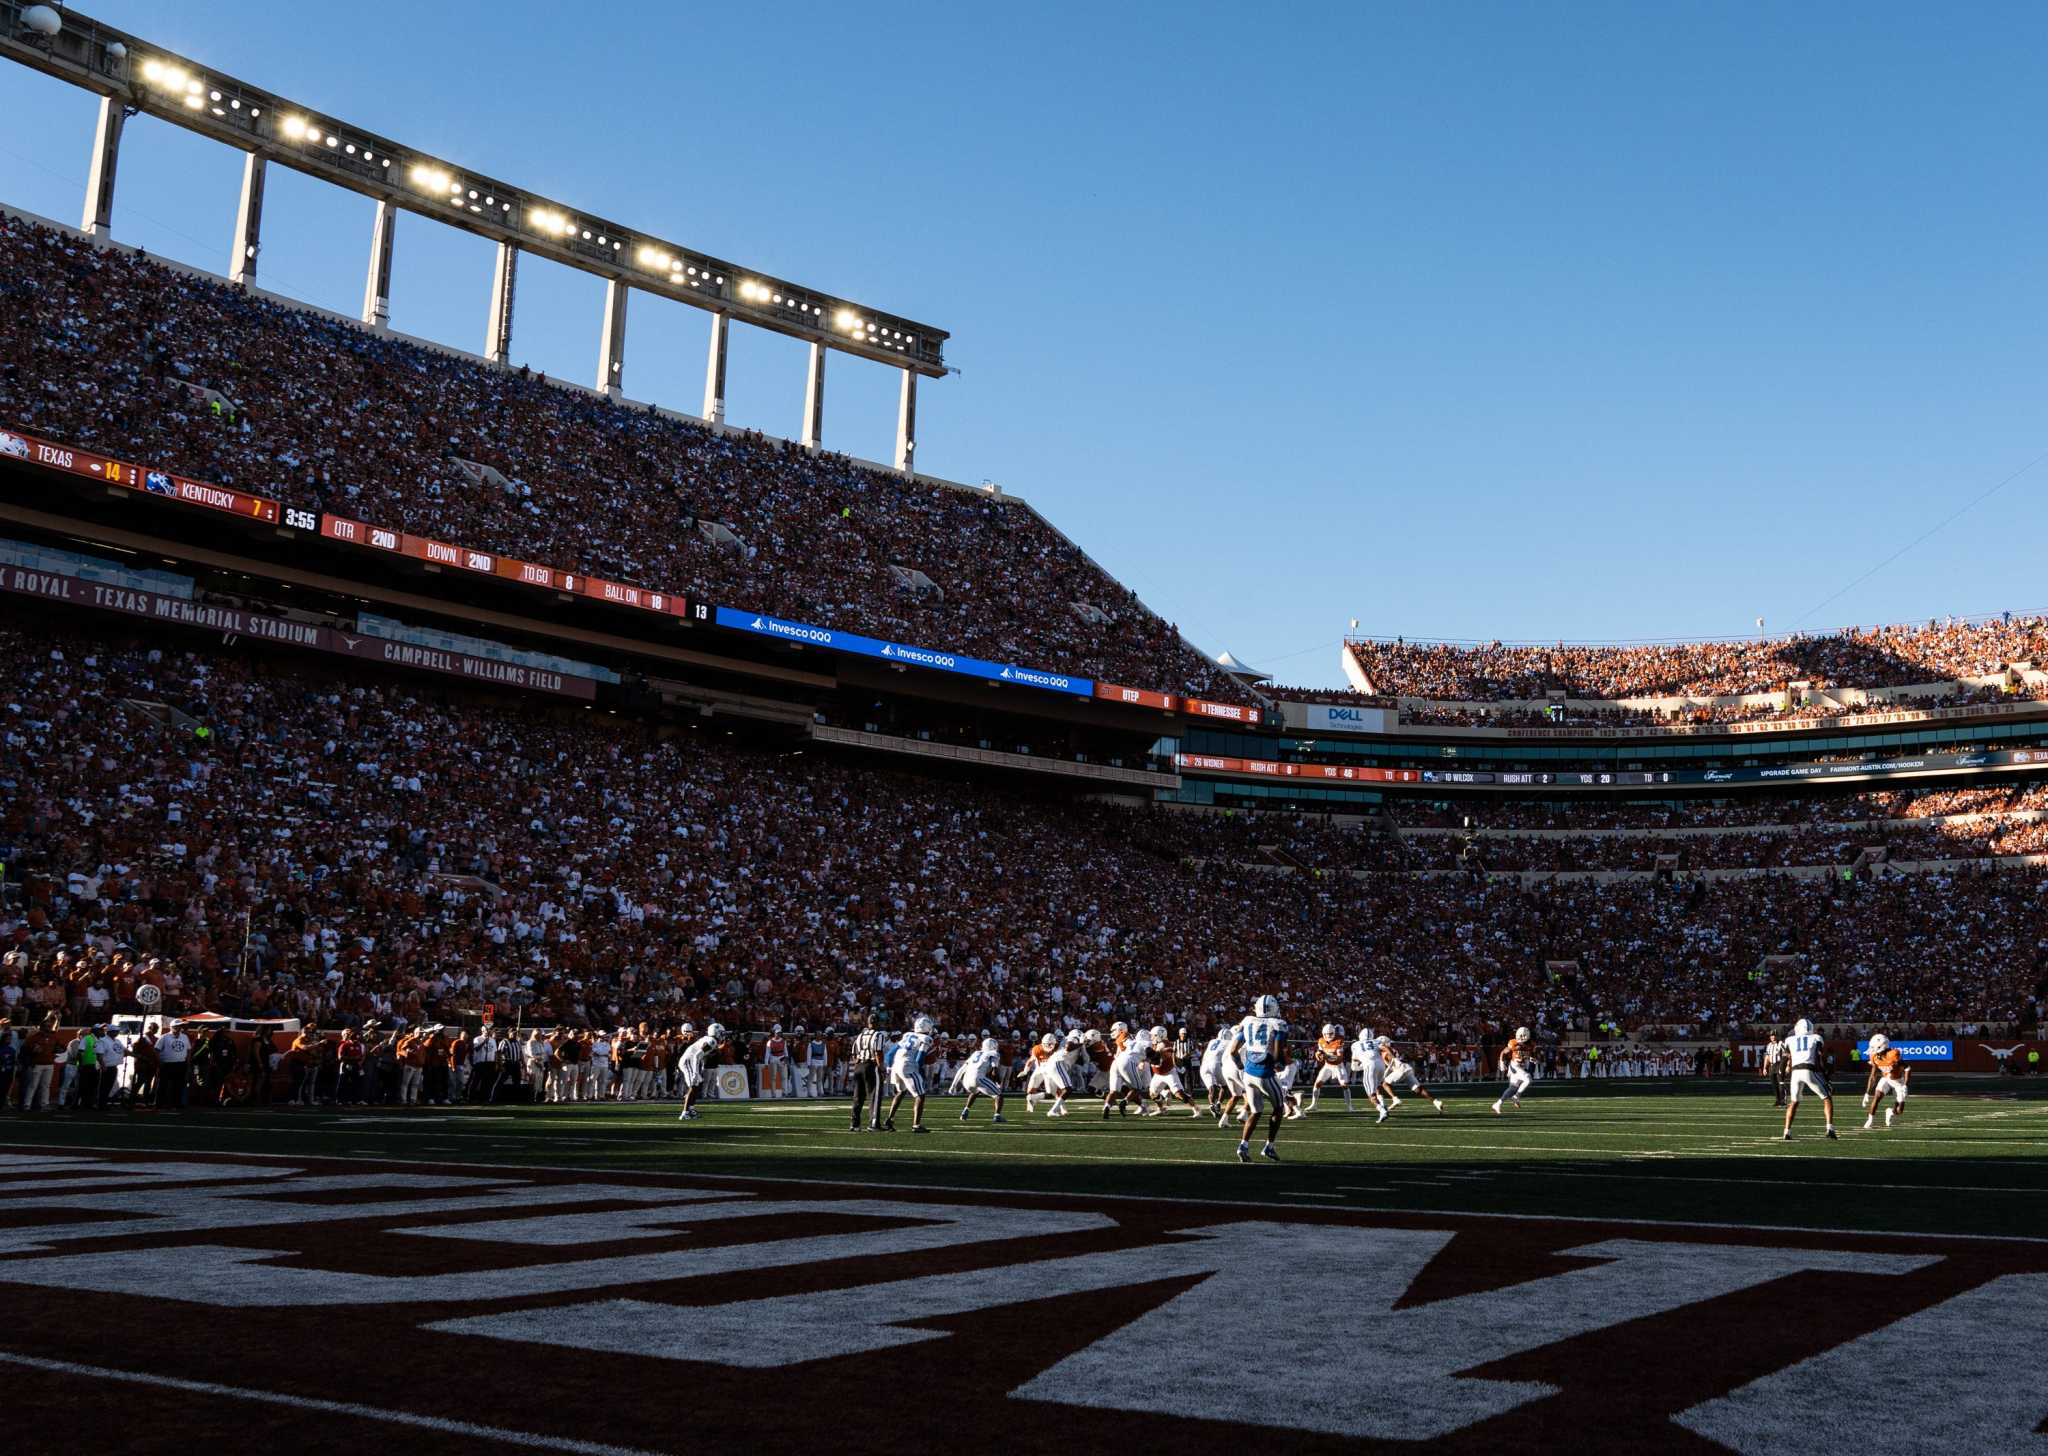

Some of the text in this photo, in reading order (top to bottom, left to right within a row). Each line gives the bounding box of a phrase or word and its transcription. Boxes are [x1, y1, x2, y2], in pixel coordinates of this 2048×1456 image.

[38, 444, 120, 481] TEXAS 14
[182, 482, 261, 516] KENTUCKY 7
[286, 508, 316, 530] 3:55
[334, 520, 396, 549] QTR 2ND
[427, 543, 490, 570] DOWN 2ND
[523, 565, 573, 590] TO GO 8
[604, 584, 624, 600] BALL
[626, 588, 638, 603] ON
[14, 571, 70, 598] ROYAL
[94, 586, 148, 612] TEXAS
[155, 598, 242, 630] MEMORIAL
[249, 617, 318, 645] STADIUM
[696, 604, 707, 620] 13
[769, 621, 831, 643] Invesco QQQ
[897, 648, 954, 667] Invesco QQQ
[384, 644, 561, 690] CAMPBELL WILLIAMS FIELD
[1015, 670, 1069, 688] Invesco QQQ
[1122, 689, 1139, 703] UTEP
[1207, 703, 1240, 718] TENNESSEE
[1328, 708, 1363, 721] DELL
[1250, 762, 1266, 771] RUSH
[1266, 764, 1276, 772] ATT
[1385, 770, 1393, 780] TD
[1453, 773, 1474, 782] WILCOX
[1503, 774, 1548, 783] RUSH ATT 2
[1580, 774, 1610, 783] YDS 20
[1644, 773, 1668, 782] TD 0
[1248, 1023, 1268, 1046] 14
[1360, 1041, 1374, 1051] 13
[1796, 1036, 1808, 1051] 11
[1924, 1045, 1947, 1055] QQQ
